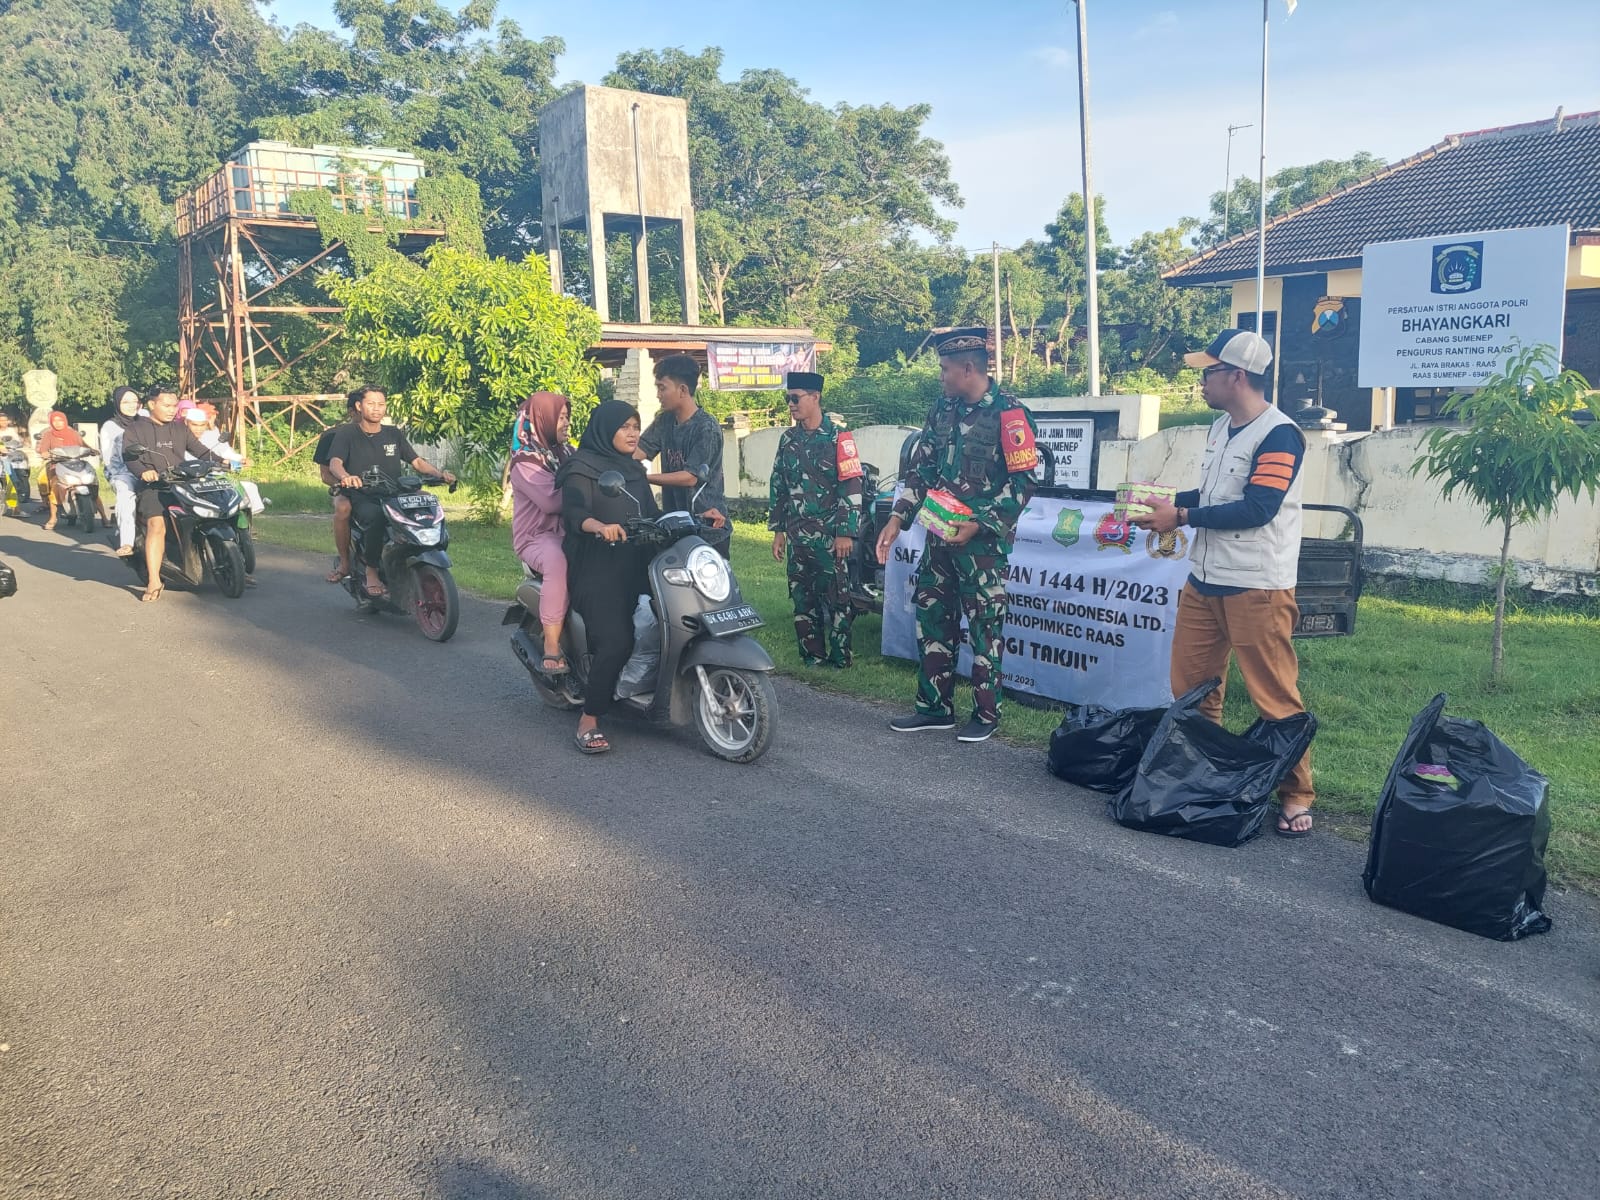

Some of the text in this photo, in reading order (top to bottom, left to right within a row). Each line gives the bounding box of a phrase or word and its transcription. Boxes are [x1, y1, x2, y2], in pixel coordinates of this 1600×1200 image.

[1388, 299, 1529, 315] PERSATUAN ISTRI ANGGOTA POLRI
[1401, 313, 1510, 332] BHAYANGKARI
[1415, 334, 1493, 344] CABANG SUMENEP
[1396, 348, 1443, 357] PENGURUS
[1445, 346, 1485, 355] RANTING
[1476, 360, 1497, 368] RAAS
[1433, 371, 1467, 379] SUMENEP
[1036, 428, 1047, 438] AH
[1066, 427, 1083, 439] TIMUR
[1055, 455, 1072, 465] AAS
[1039, 570, 1085, 592] 1444
[1092, 577, 1169, 606] H/2023
[1006, 592, 1166, 633] NERGY INDONESIA LTD.
[1004, 612, 1125, 648] RKOPIMKEC RAAS
[1014, 676, 1036, 687] 2023
